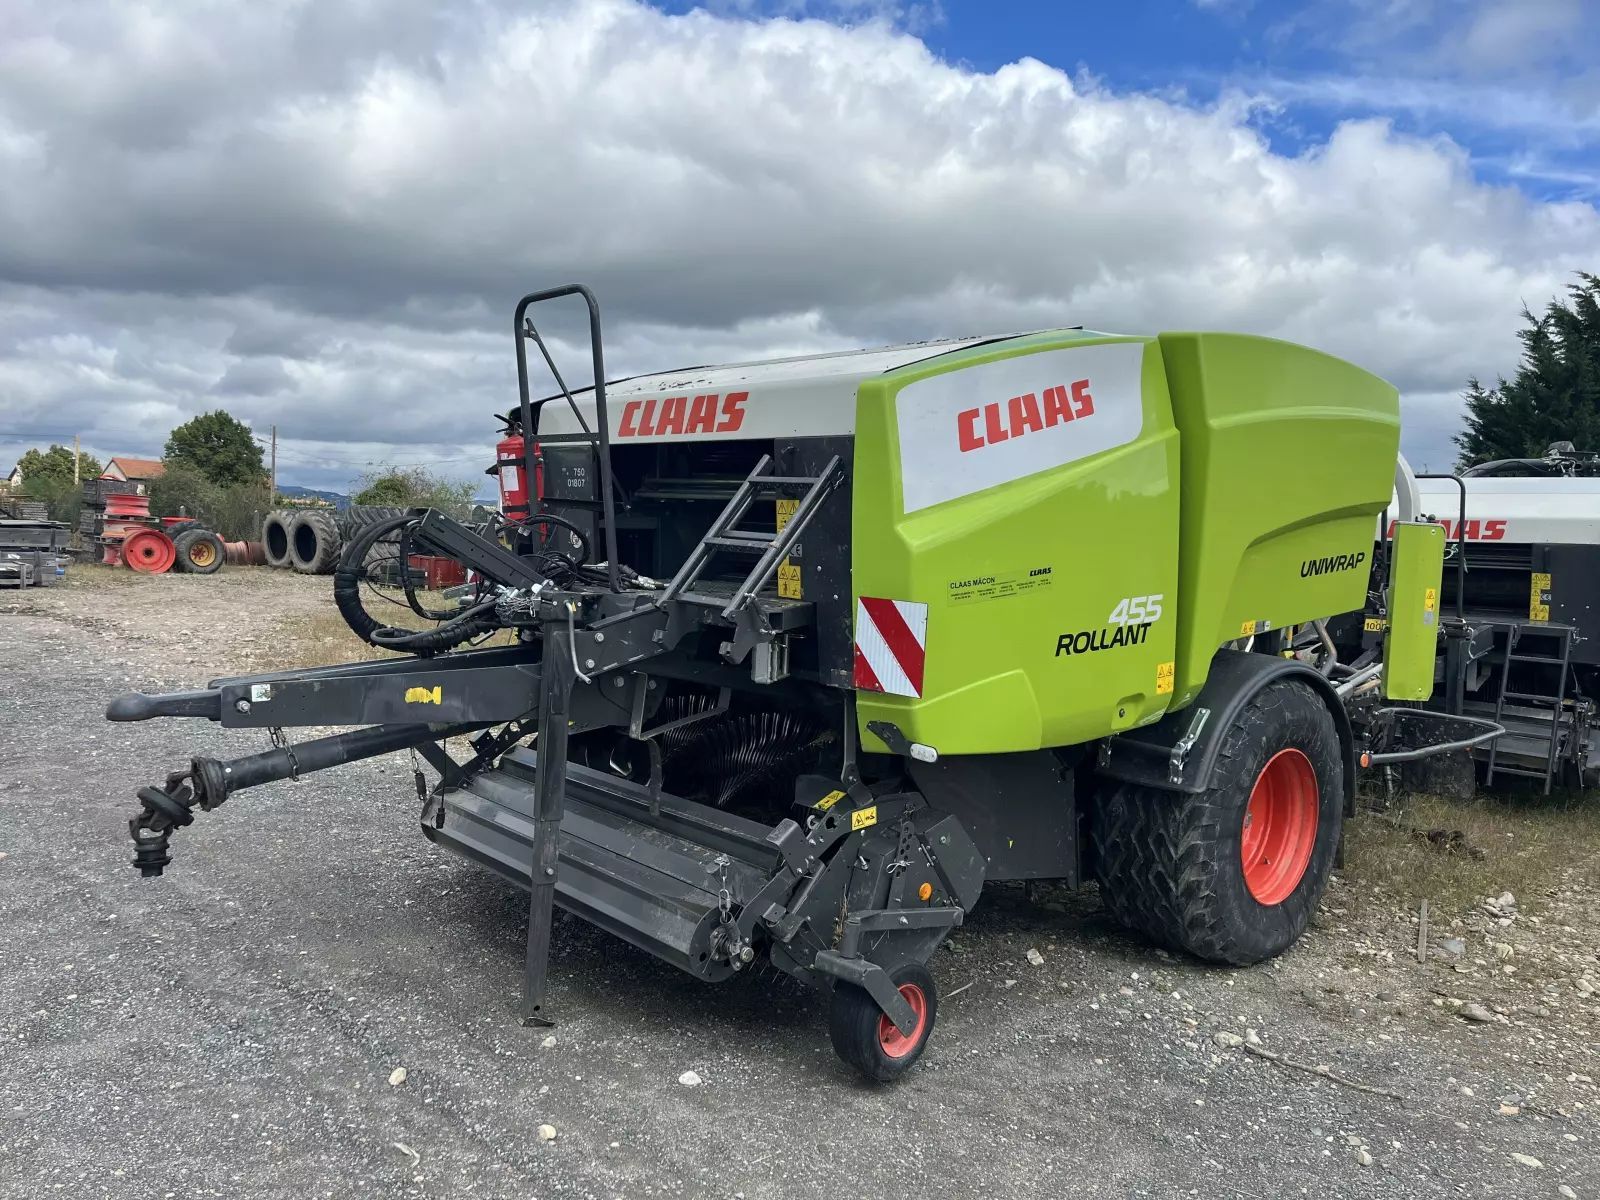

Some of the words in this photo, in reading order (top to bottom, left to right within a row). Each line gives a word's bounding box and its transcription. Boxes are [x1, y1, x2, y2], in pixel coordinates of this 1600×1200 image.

[618, 392, 749, 437] CLAAS
[957, 379, 1094, 452] CLAAS
[1029, 567, 1052, 577] CLAAS
[1300, 552, 1365, 578] UNIWRAP
[950, 580, 972, 589] CLAAS
[1108, 594, 1163, 627] 455
[1055, 622, 1152, 657] ROLLANT
